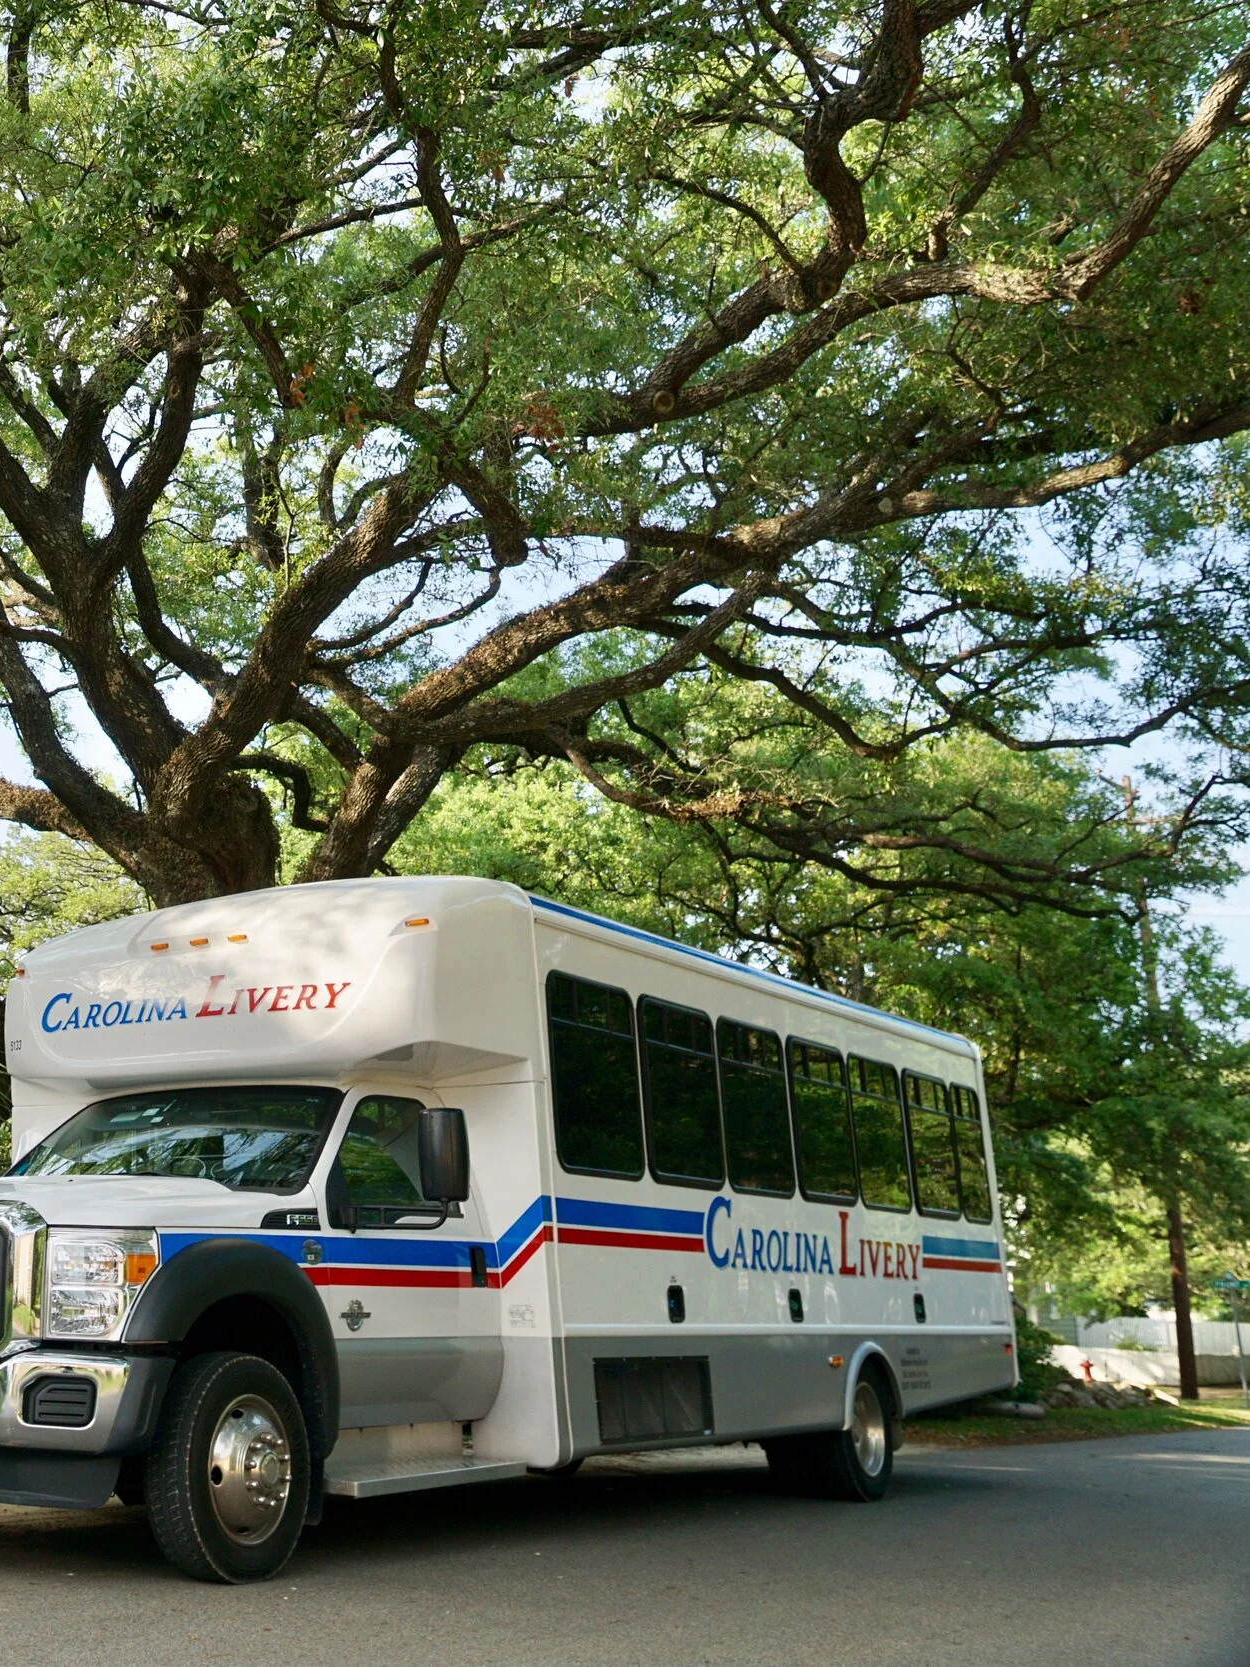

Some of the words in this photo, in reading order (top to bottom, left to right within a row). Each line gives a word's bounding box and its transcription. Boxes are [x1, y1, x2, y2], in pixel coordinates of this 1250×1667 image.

[41, 992, 187, 1033] CAROLINA
[196, 975, 351, 1018] LIVERY
[10, 1039, 22, 1052] 5133
[706, 1196, 834, 1275] CAROLINA
[839, 1211, 921, 1280] LIVERY
